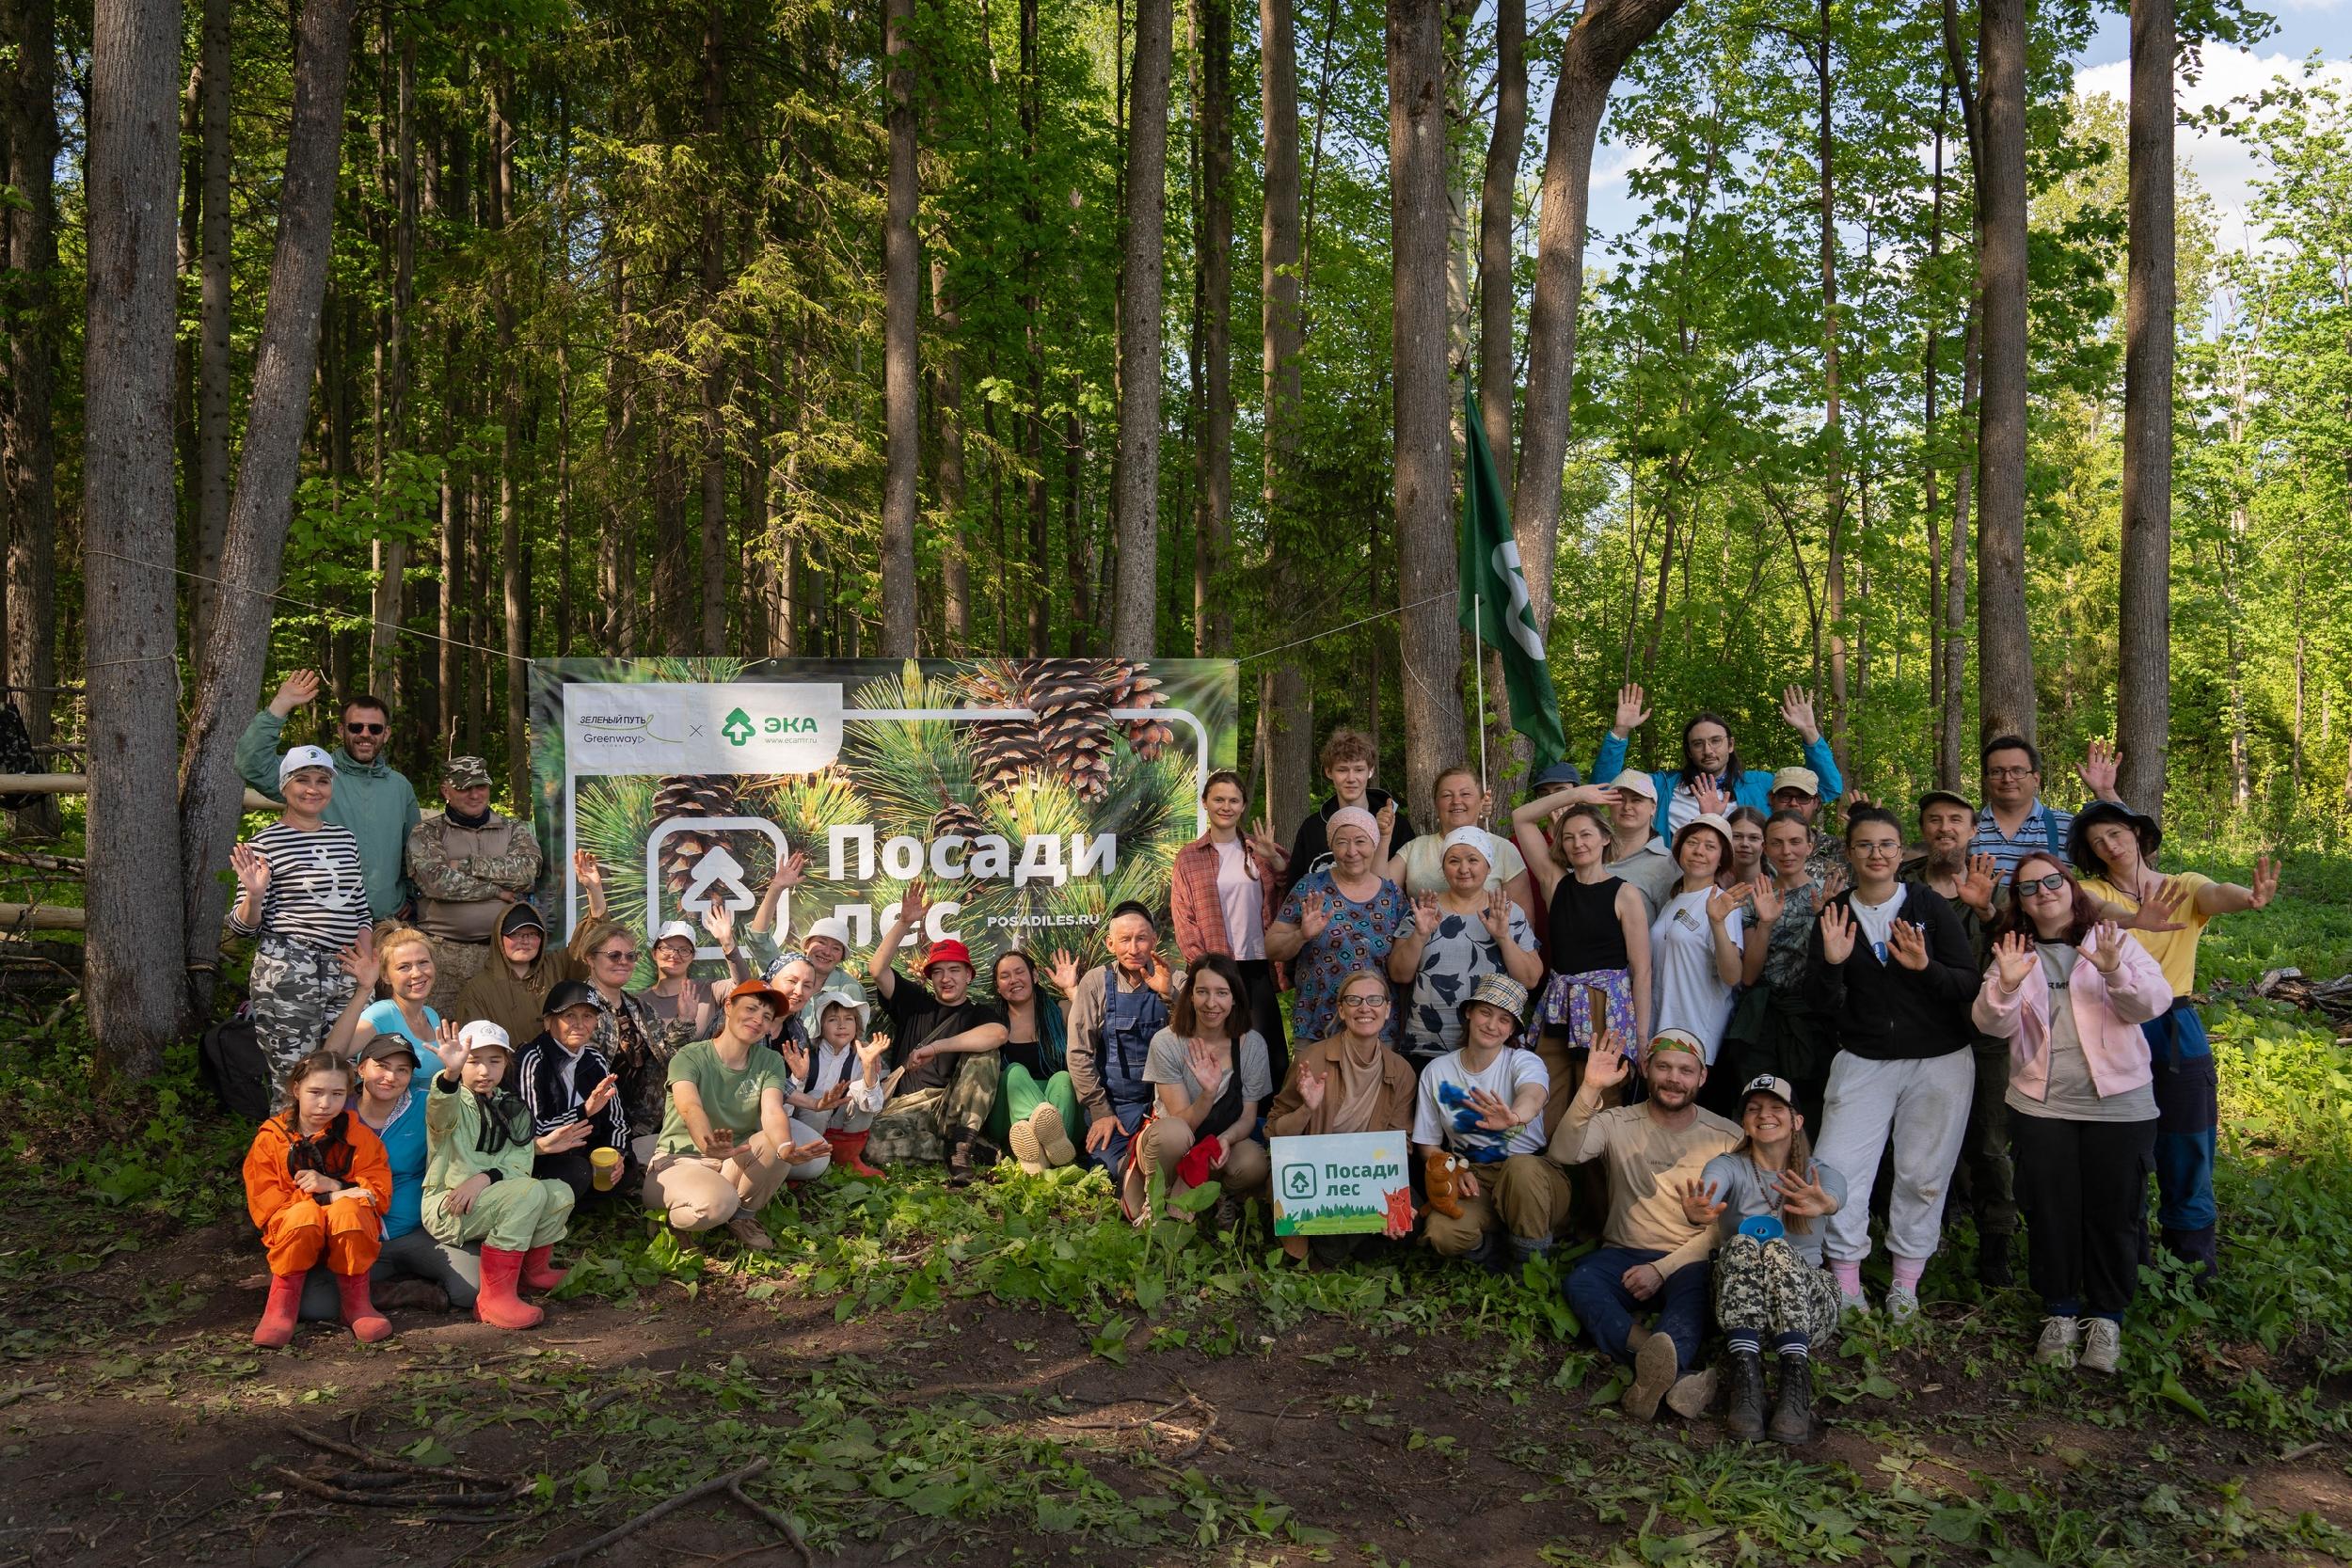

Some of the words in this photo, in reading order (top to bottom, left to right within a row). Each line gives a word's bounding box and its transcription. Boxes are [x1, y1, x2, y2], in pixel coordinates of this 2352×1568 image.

[624, 716, 646, 724] ПУТЬ
[764, 717, 818, 733] ЭКА
[583, 733, 638, 745] Greenway
[828, 824, 1117, 887] Посади
[987, 914, 1101, 927] POSADILES.RU
[1325, 1164, 1399, 1180] Посади
[1326, 1183, 1360, 1196] лес
